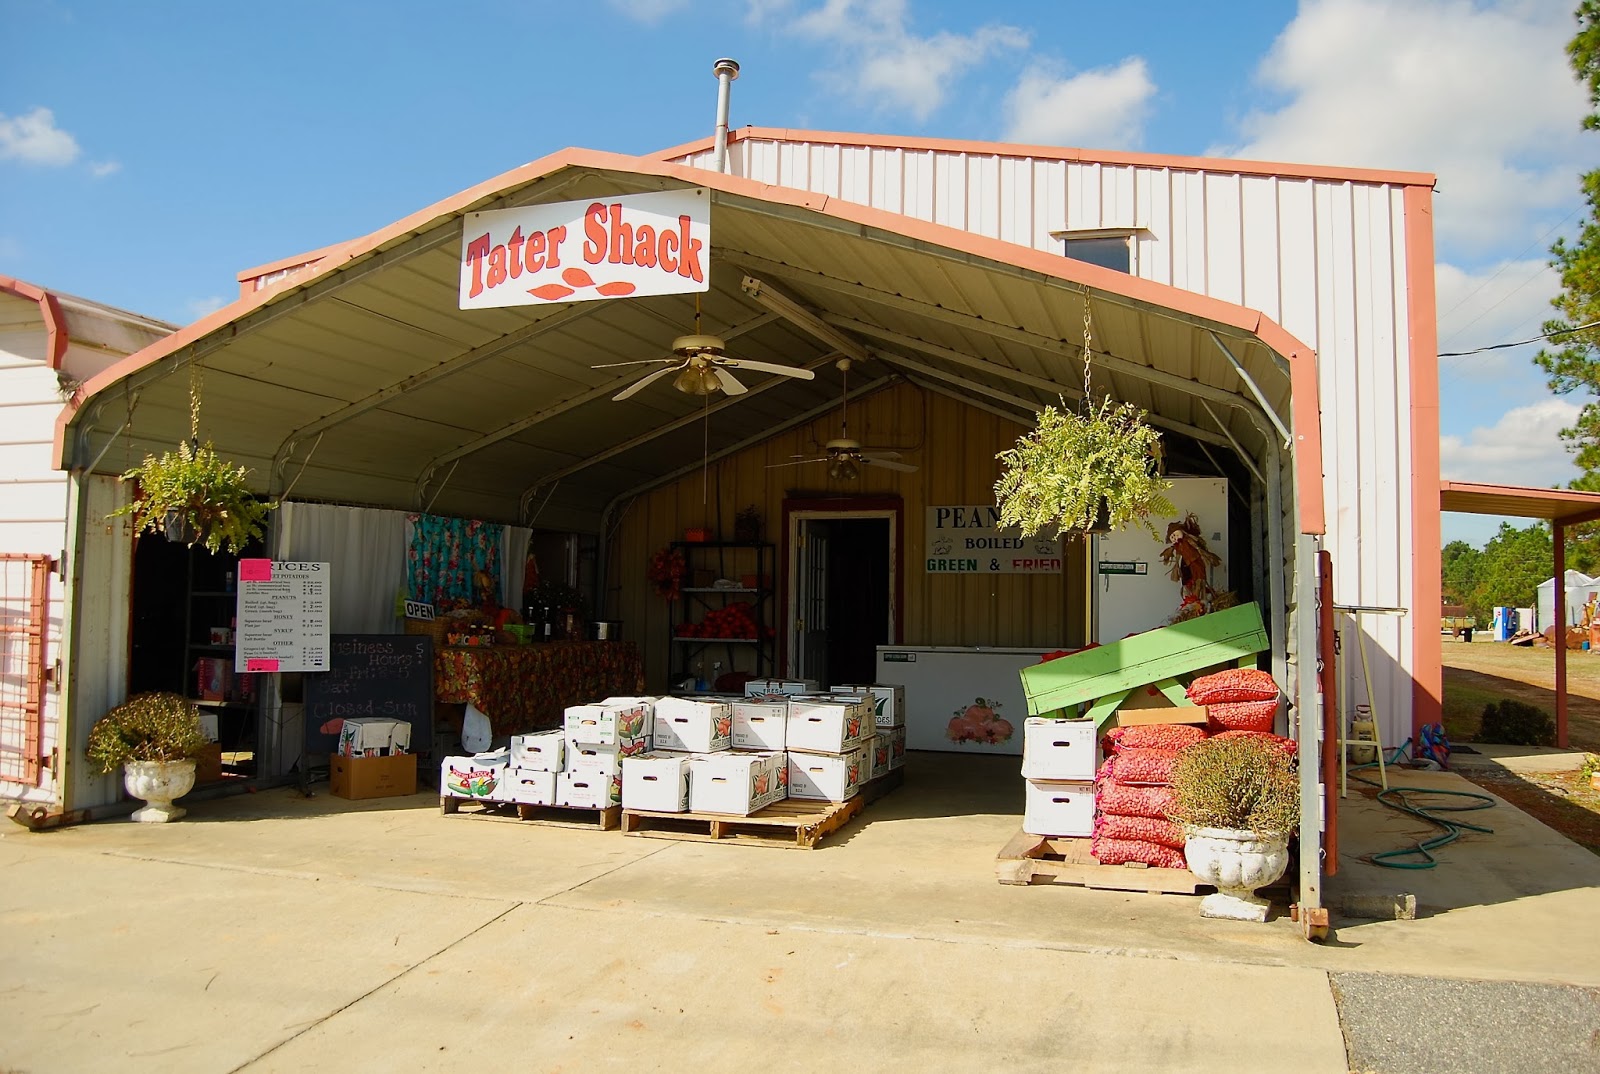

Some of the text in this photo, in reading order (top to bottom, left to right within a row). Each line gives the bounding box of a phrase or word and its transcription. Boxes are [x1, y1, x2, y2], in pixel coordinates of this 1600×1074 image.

[466, 202, 704, 299] Tater Shack
[936, 507, 1002, 529] PEAN
[965, 537, 1025, 550] BOILED
[926, 558, 1061, 571] GREEN & FRIED
[406, 602, 434, 620] OPEN
[332, 639, 394, 655] usiness
